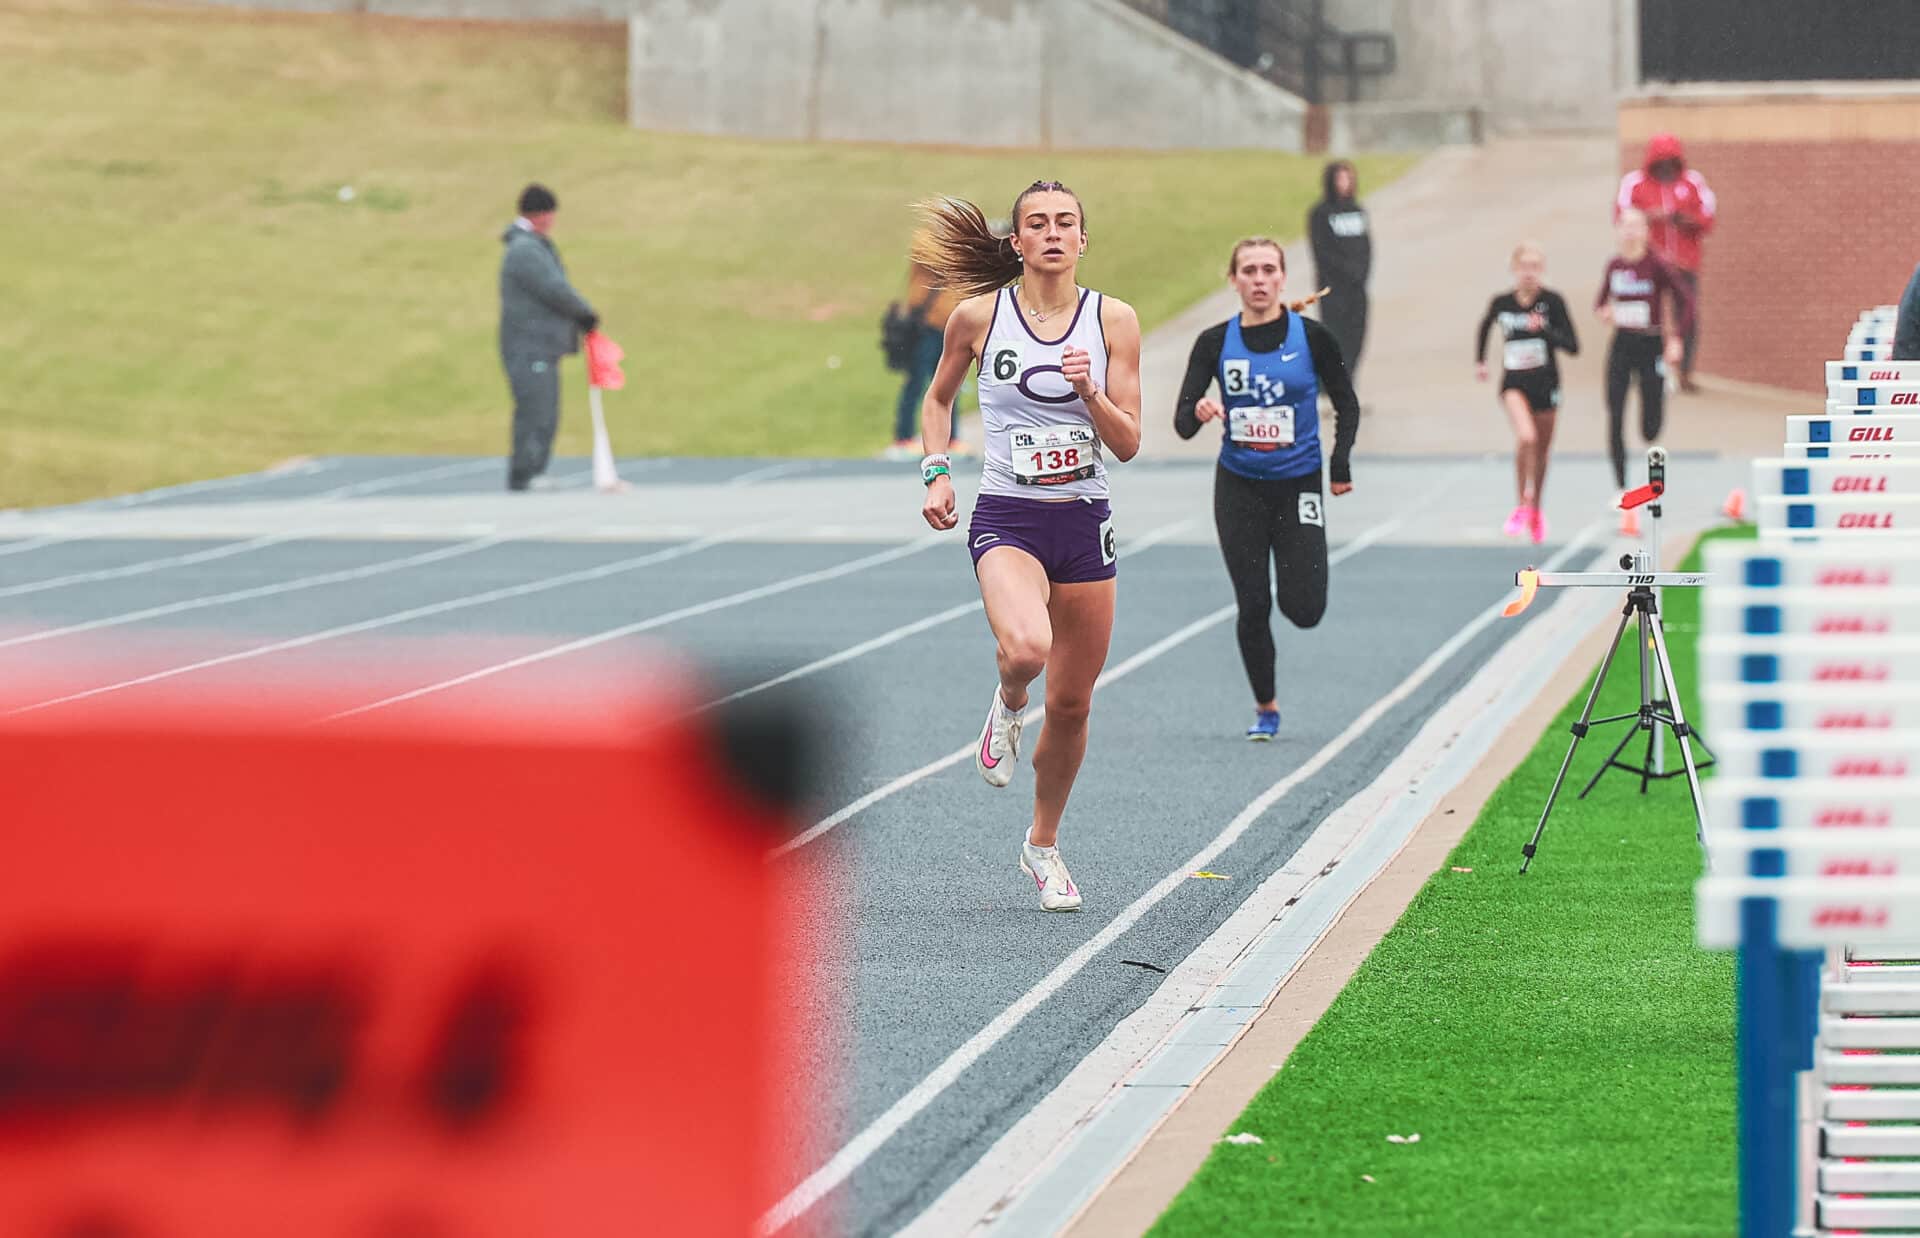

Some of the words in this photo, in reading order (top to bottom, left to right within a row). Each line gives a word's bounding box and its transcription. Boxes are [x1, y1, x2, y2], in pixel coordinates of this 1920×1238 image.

[994, 349, 1018, 380] 6
[1228, 368, 1243, 392] 3
[1869, 371, 1901, 381] GILL
[1890, 393, 1920, 405] GIL
[1243, 424, 1280, 439] 360
[1848, 427, 1894, 441] GILL
[1030, 448, 1079, 471] 138
[1303, 501, 1319, 520] 3
[1104, 526, 1116, 559] 6
